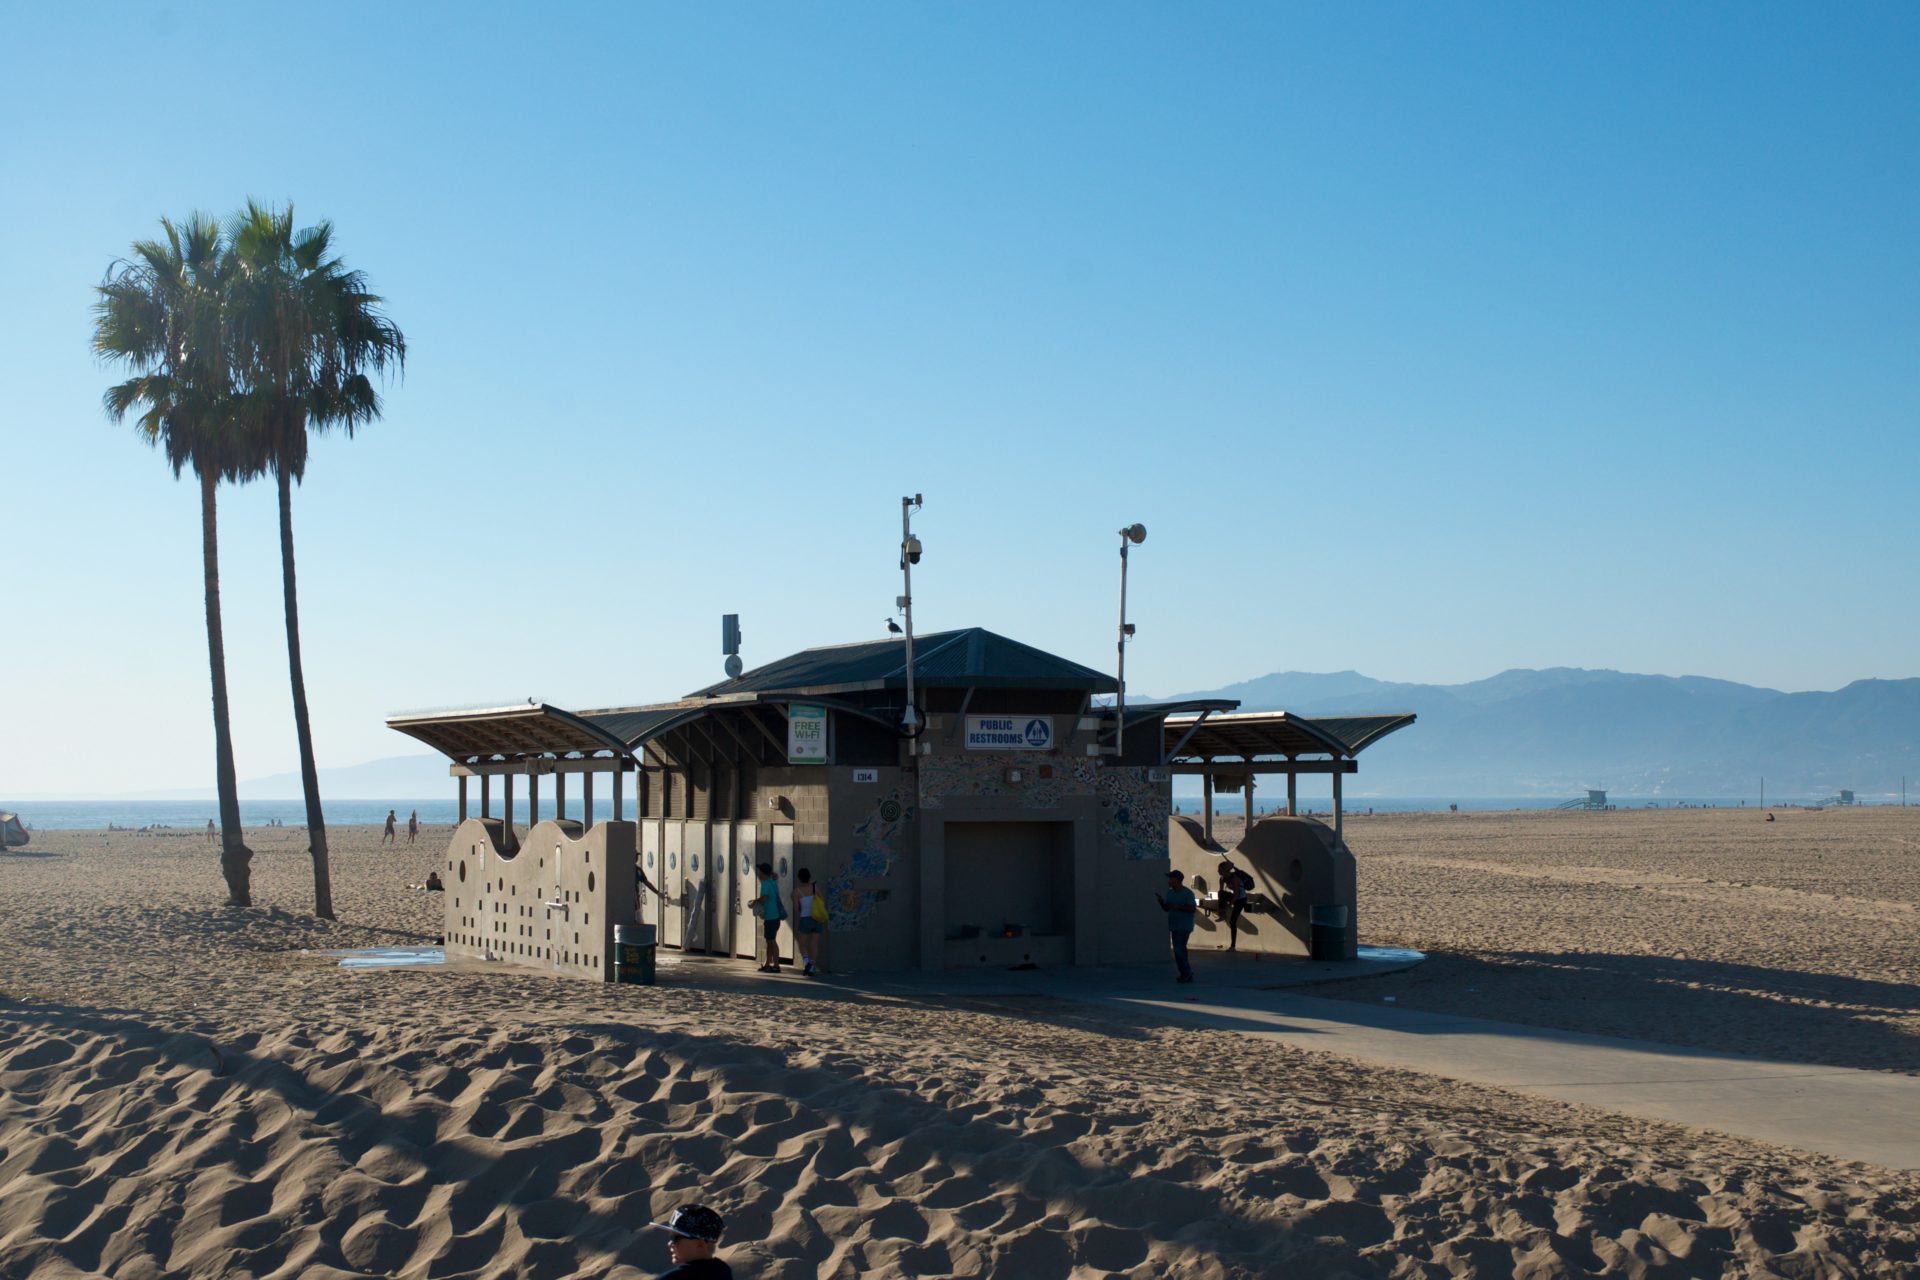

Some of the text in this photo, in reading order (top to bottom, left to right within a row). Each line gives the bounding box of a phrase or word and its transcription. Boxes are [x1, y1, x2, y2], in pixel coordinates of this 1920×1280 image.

[794, 721, 821, 731] FREE
[980, 719, 1013, 731] PUBLIC
[969, 732, 1024, 744] RESTROOMS
[857, 773, 872, 782] 1314
